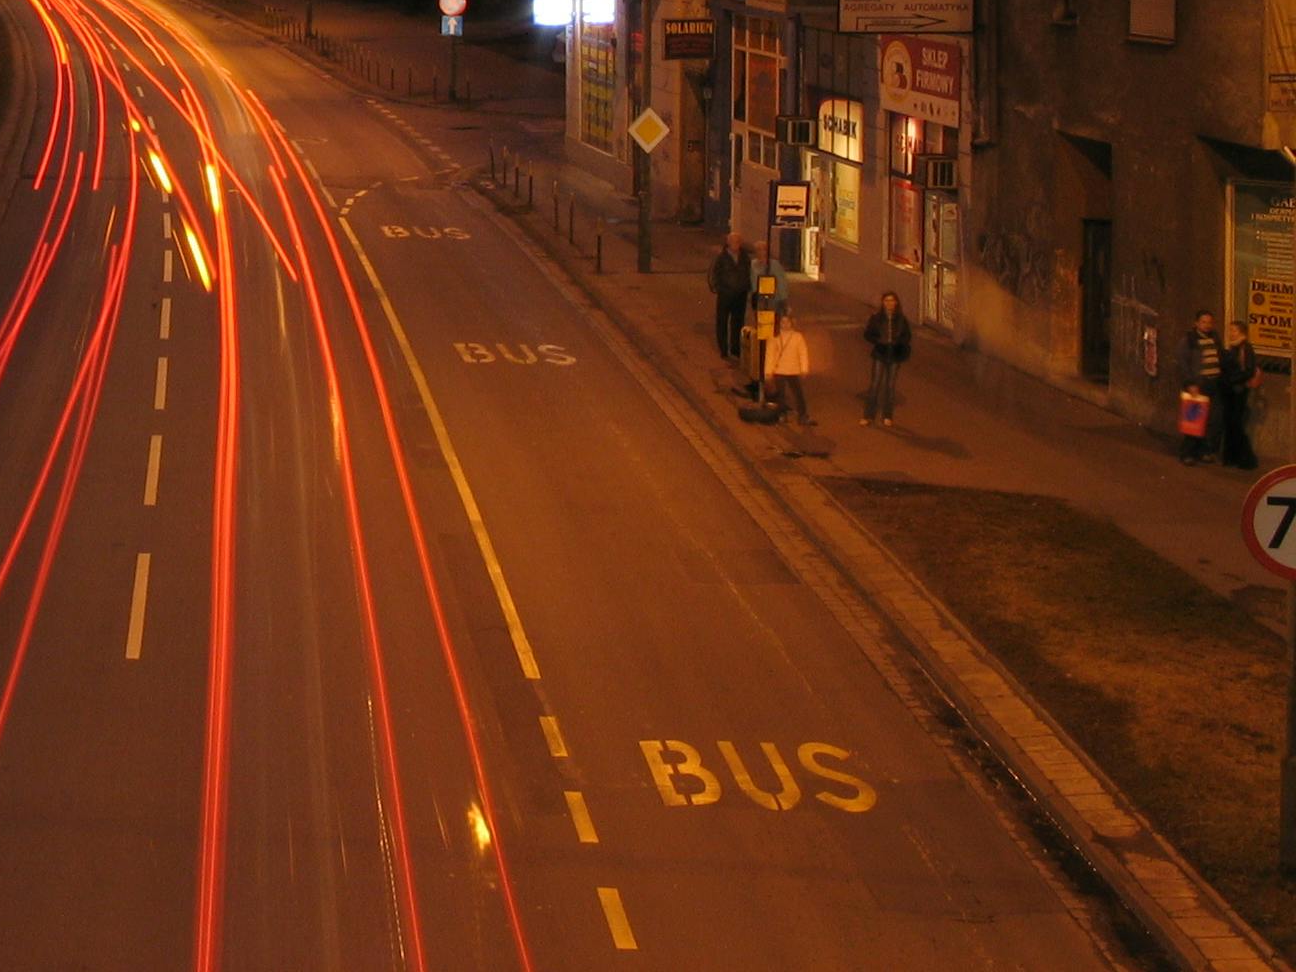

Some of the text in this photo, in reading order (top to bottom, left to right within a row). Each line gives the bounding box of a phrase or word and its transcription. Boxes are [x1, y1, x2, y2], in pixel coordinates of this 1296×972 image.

[844, 3, 896, 12] AGREGATY
[903, 3, 969, 12] AUTOMATYKA
[665, 22, 713, 34] SOLARIUM
[921, 46, 949, 68] SKLEP
[916, 68, 954, 96] FIRMOWY
[381, 225, 472, 240] BUS
[453, 342, 577, 365] BUS
[638, 739, 878, 813] BUS
